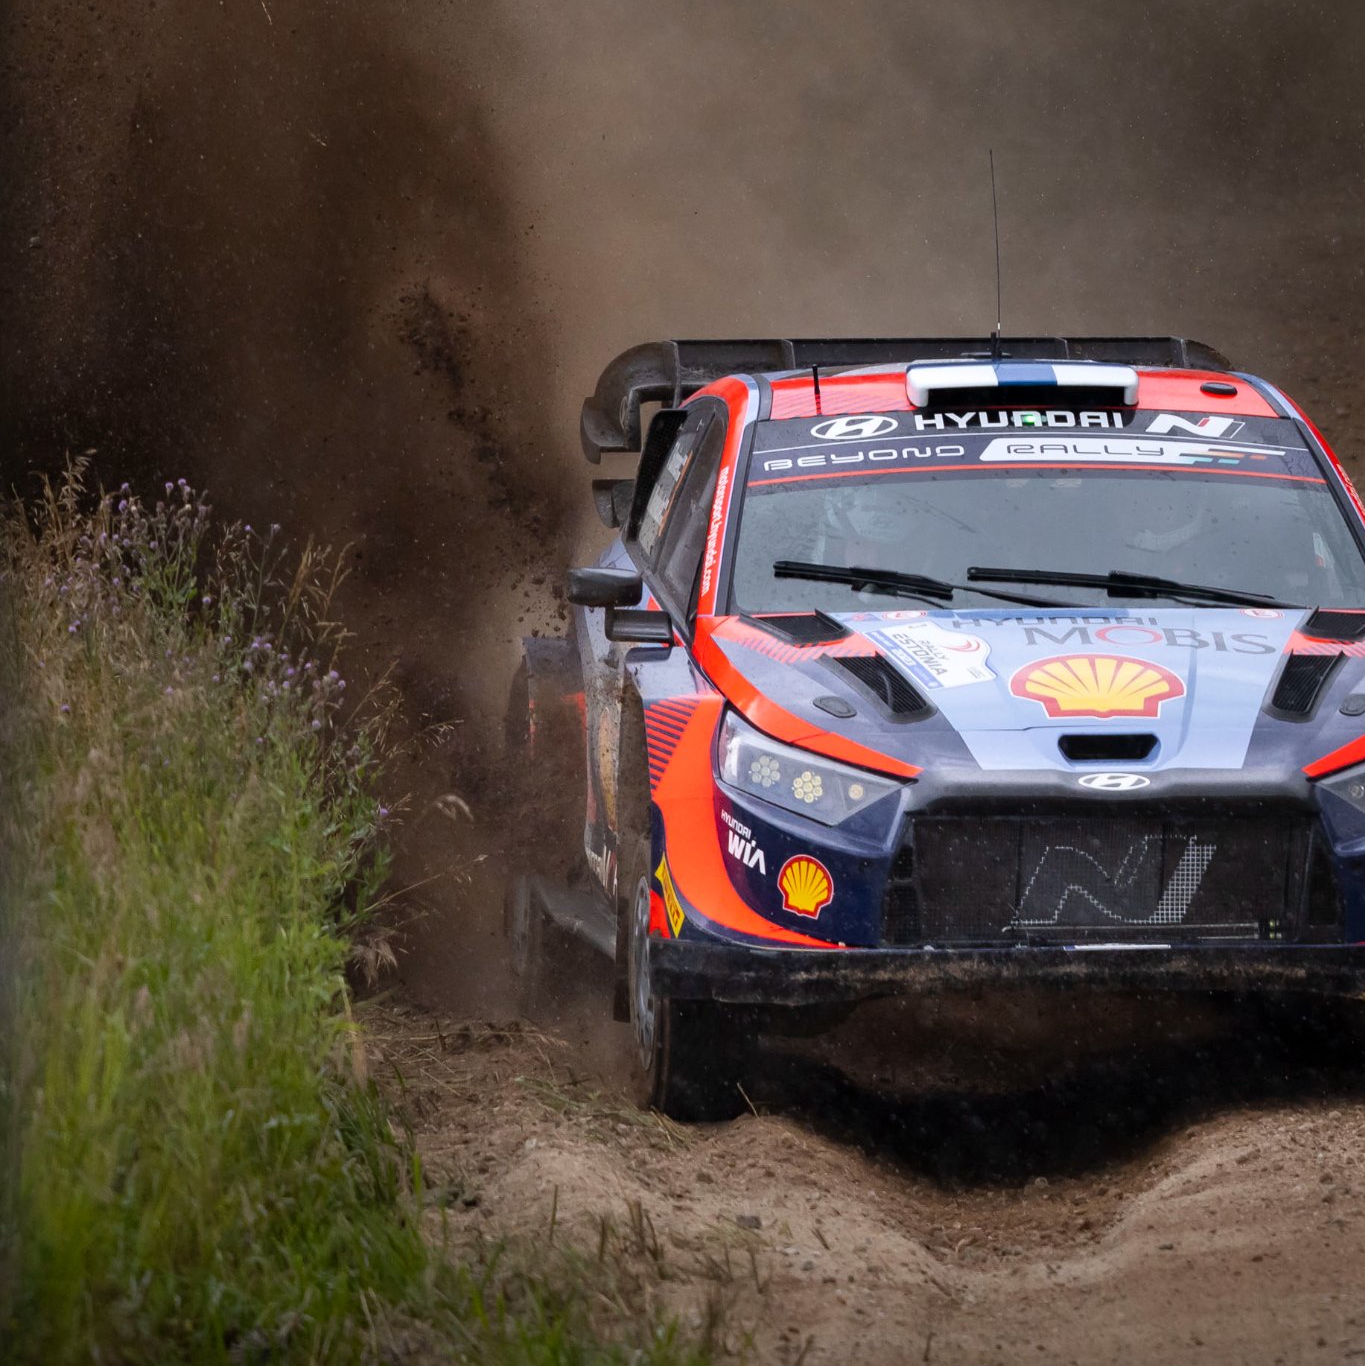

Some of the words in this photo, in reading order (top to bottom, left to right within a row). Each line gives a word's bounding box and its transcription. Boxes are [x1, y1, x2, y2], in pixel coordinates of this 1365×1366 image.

[914, 410, 1125, 431] HYUNDAI
[763, 445, 965, 472] BEYOND
[1006, 443, 1165, 456] RALLY
[952, 616, 1158, 629] HYUNDAI
[918, 640, 949, 660] RALLY
[1023, 625, 1277, 654] MOBIS
[891, 633, 948, 676] ESTONIA
[720, 810, 752, 839] HYUNDAI
